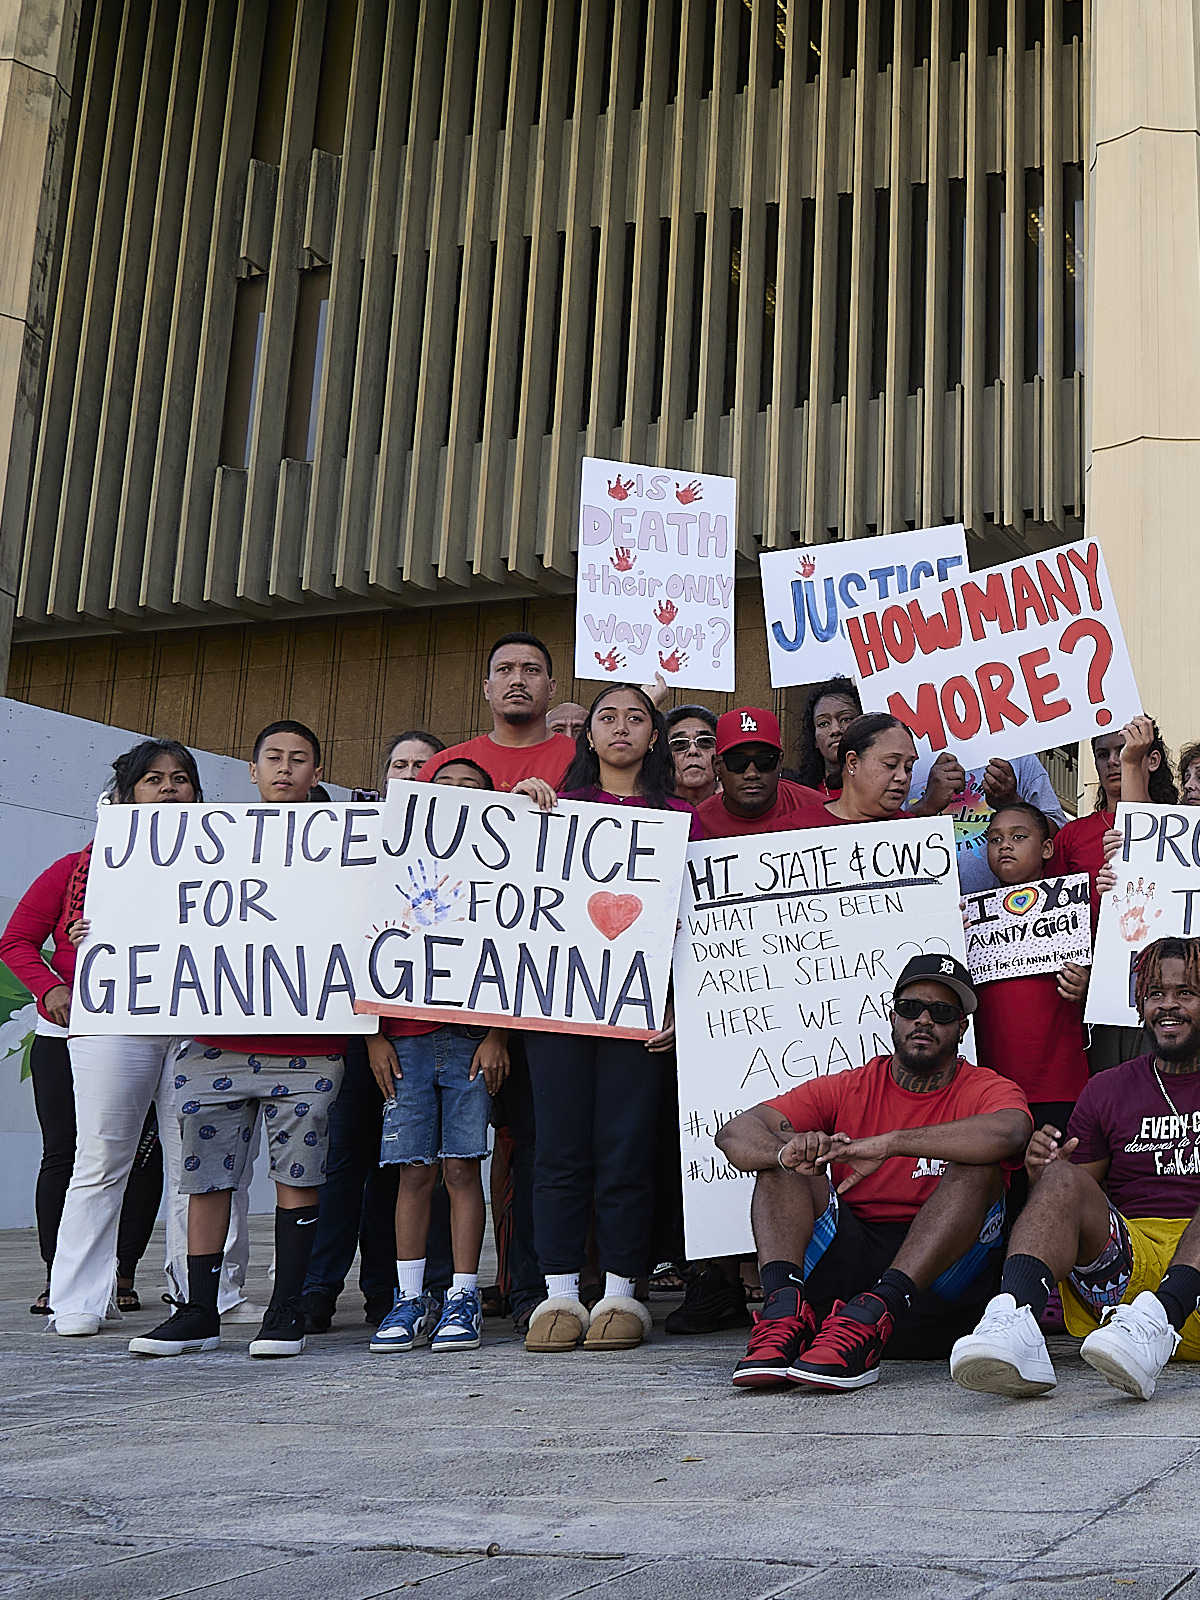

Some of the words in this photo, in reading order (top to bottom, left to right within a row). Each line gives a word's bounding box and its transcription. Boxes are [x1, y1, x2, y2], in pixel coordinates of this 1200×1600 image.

[636, 473, 670, 500] IS
[583, 504, 728, 558] DEATH
[582, 563, 662, 597] their
[666, 573, 733, 608] ONLY
[846, 587, 963, 679] HOW
[961, 542, 1103, 641] MANY
[887, 617, 1114, 753] MORE?
[740, 711, 758, 732] LA
[104, 808, 379, 870] JUSTICE
[383, 793, 666, 884] JUSTICE
[687, 855, 743, 900] HI
[755, 845, 841, 892] STATE
[849, 842, 867, 880] &
[872, 833, 951, 879] CWS
[178, 878, 278, 928] FOR
[467, 880, 566, 933] FOR
[688, 906, 759, 936] WHAT
[777, 898, 828, 927] HAS
[839, 892, 904, 917] BEEN
[963, 892, 1000, 929] I
[691, 938, 751, 963] DONE
[762, 929, 840, 955] SINCE
[968, 922, 1028, 952] AUNTY
[1012, 954, 1052, 967] GEANNA
[79, 943, 356, 1021] GEANNA
[368, 927, 657, 1032] GEANNA
[697, 964, 785, 997] ARIEL
[794, 949, 893, 985] SELLAR
[706, 1004, 782, 1038] HERE
[798, 998, 842, 1029] WE
[858, 991, 895, 1024] AR
[1124, 1134, 1175, 1153] deserves
[1178, 1136, 1192, 1148] to
[1140, 1113, 1189, 1140] EVERY
